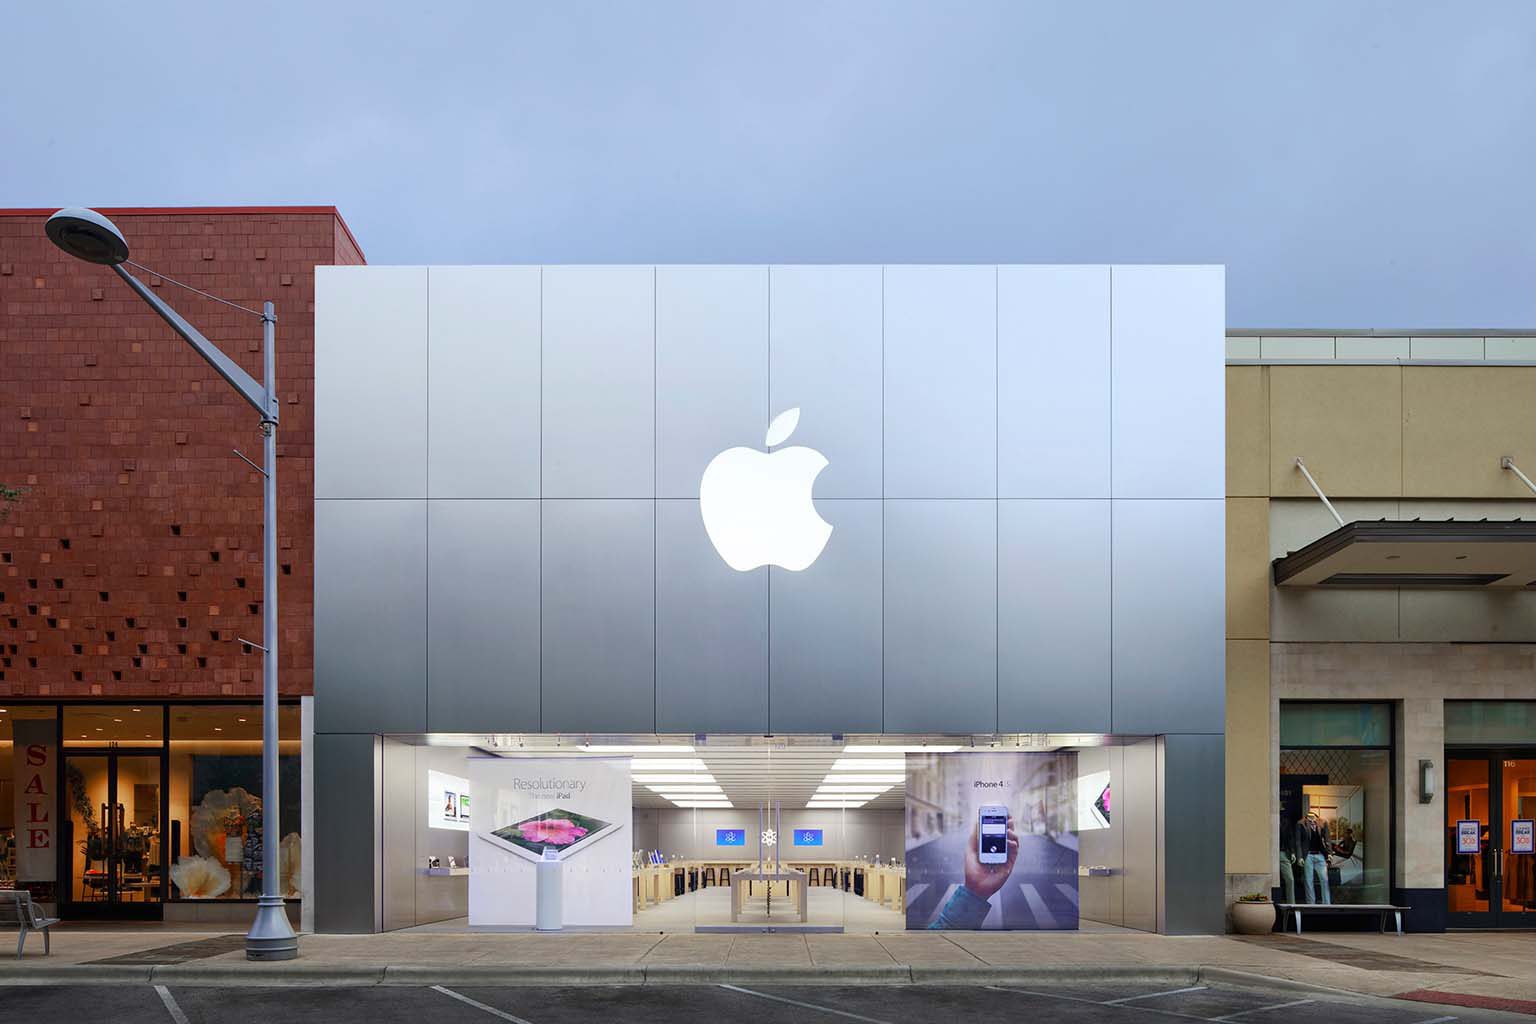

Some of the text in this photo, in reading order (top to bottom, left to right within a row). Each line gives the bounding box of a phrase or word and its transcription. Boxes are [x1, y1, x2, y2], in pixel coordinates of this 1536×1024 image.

[1503, 760, 1516, 768] 116
[513, 777, 586, 792] Resolutionary
[974, 780, 998, 788] iPhone
[24, 744, 50, 849] SALE
